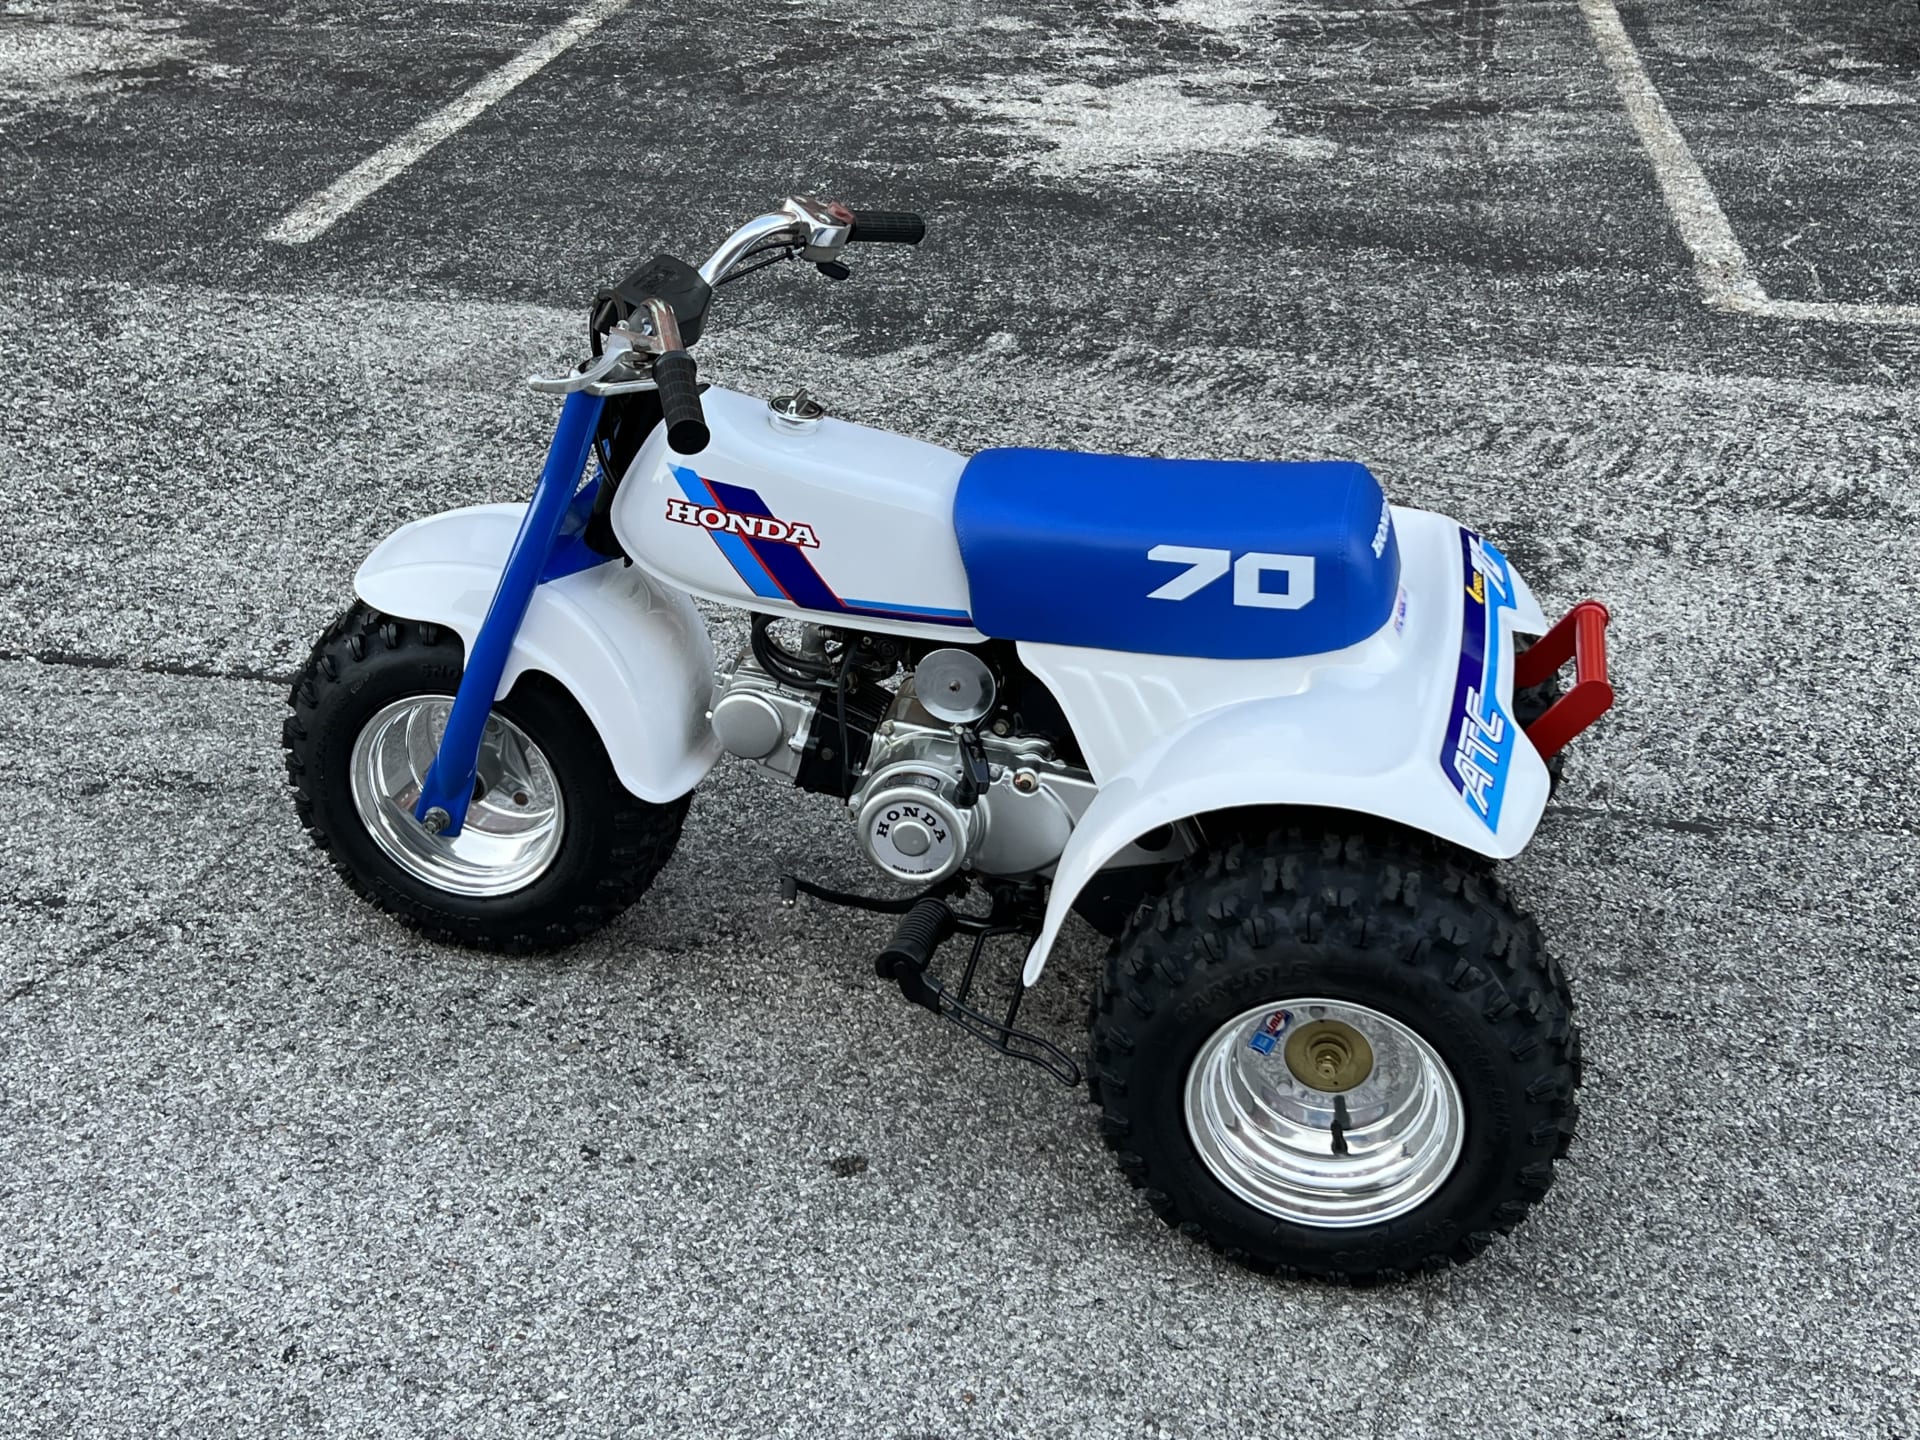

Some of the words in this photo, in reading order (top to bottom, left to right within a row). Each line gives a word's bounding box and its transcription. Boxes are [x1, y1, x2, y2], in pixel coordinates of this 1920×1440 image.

[666, 498, 820, 548] HONDA
[1146, 544, 1315, 610] 70
[1453, 686, 1504, 816] ATC
[877, 807, 946, 843] HONDA
